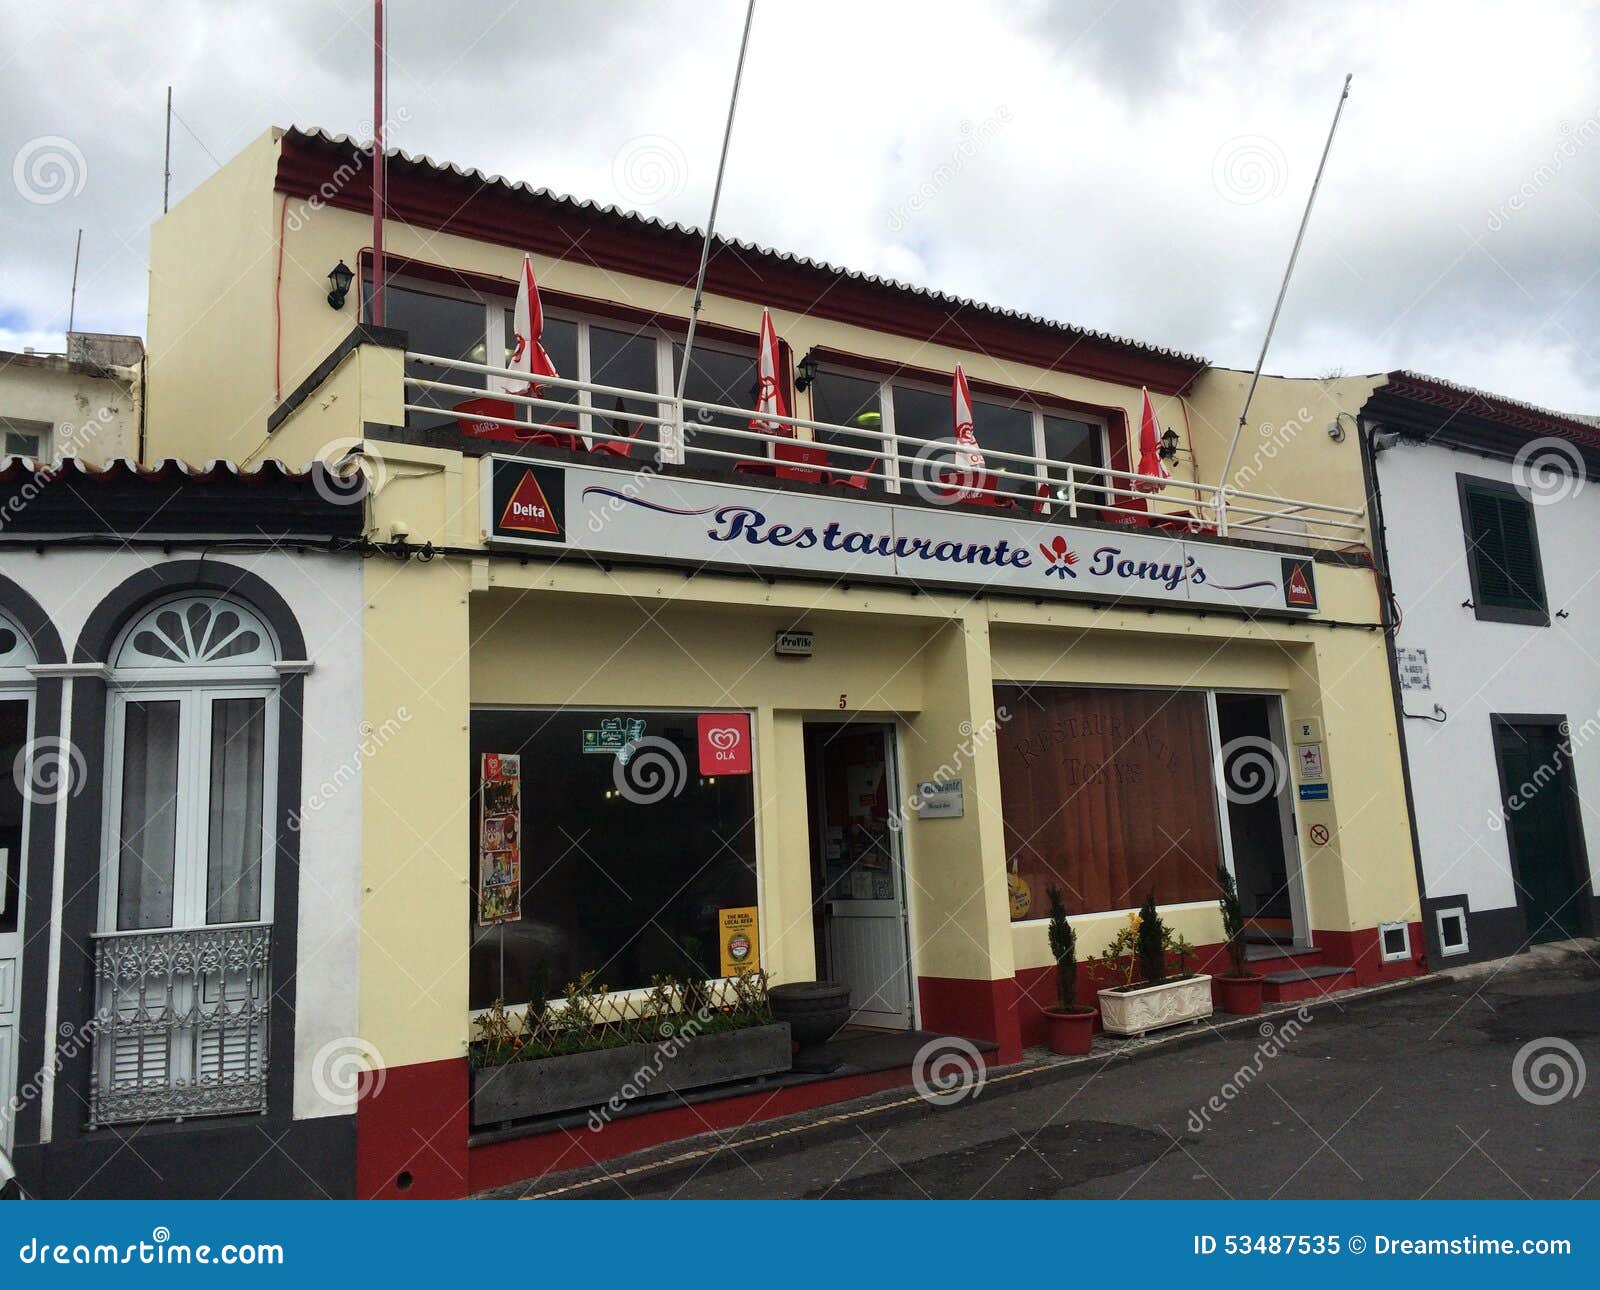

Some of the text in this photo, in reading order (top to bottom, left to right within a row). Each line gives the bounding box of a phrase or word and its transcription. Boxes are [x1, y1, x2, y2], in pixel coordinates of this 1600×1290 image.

[513, 502, 545, 518] Delta
[707, 505, 1207, 591] Restaurante Tony's
[1291, 584, 1308, 595] Delta
[839, 694, 847, 709] 5
